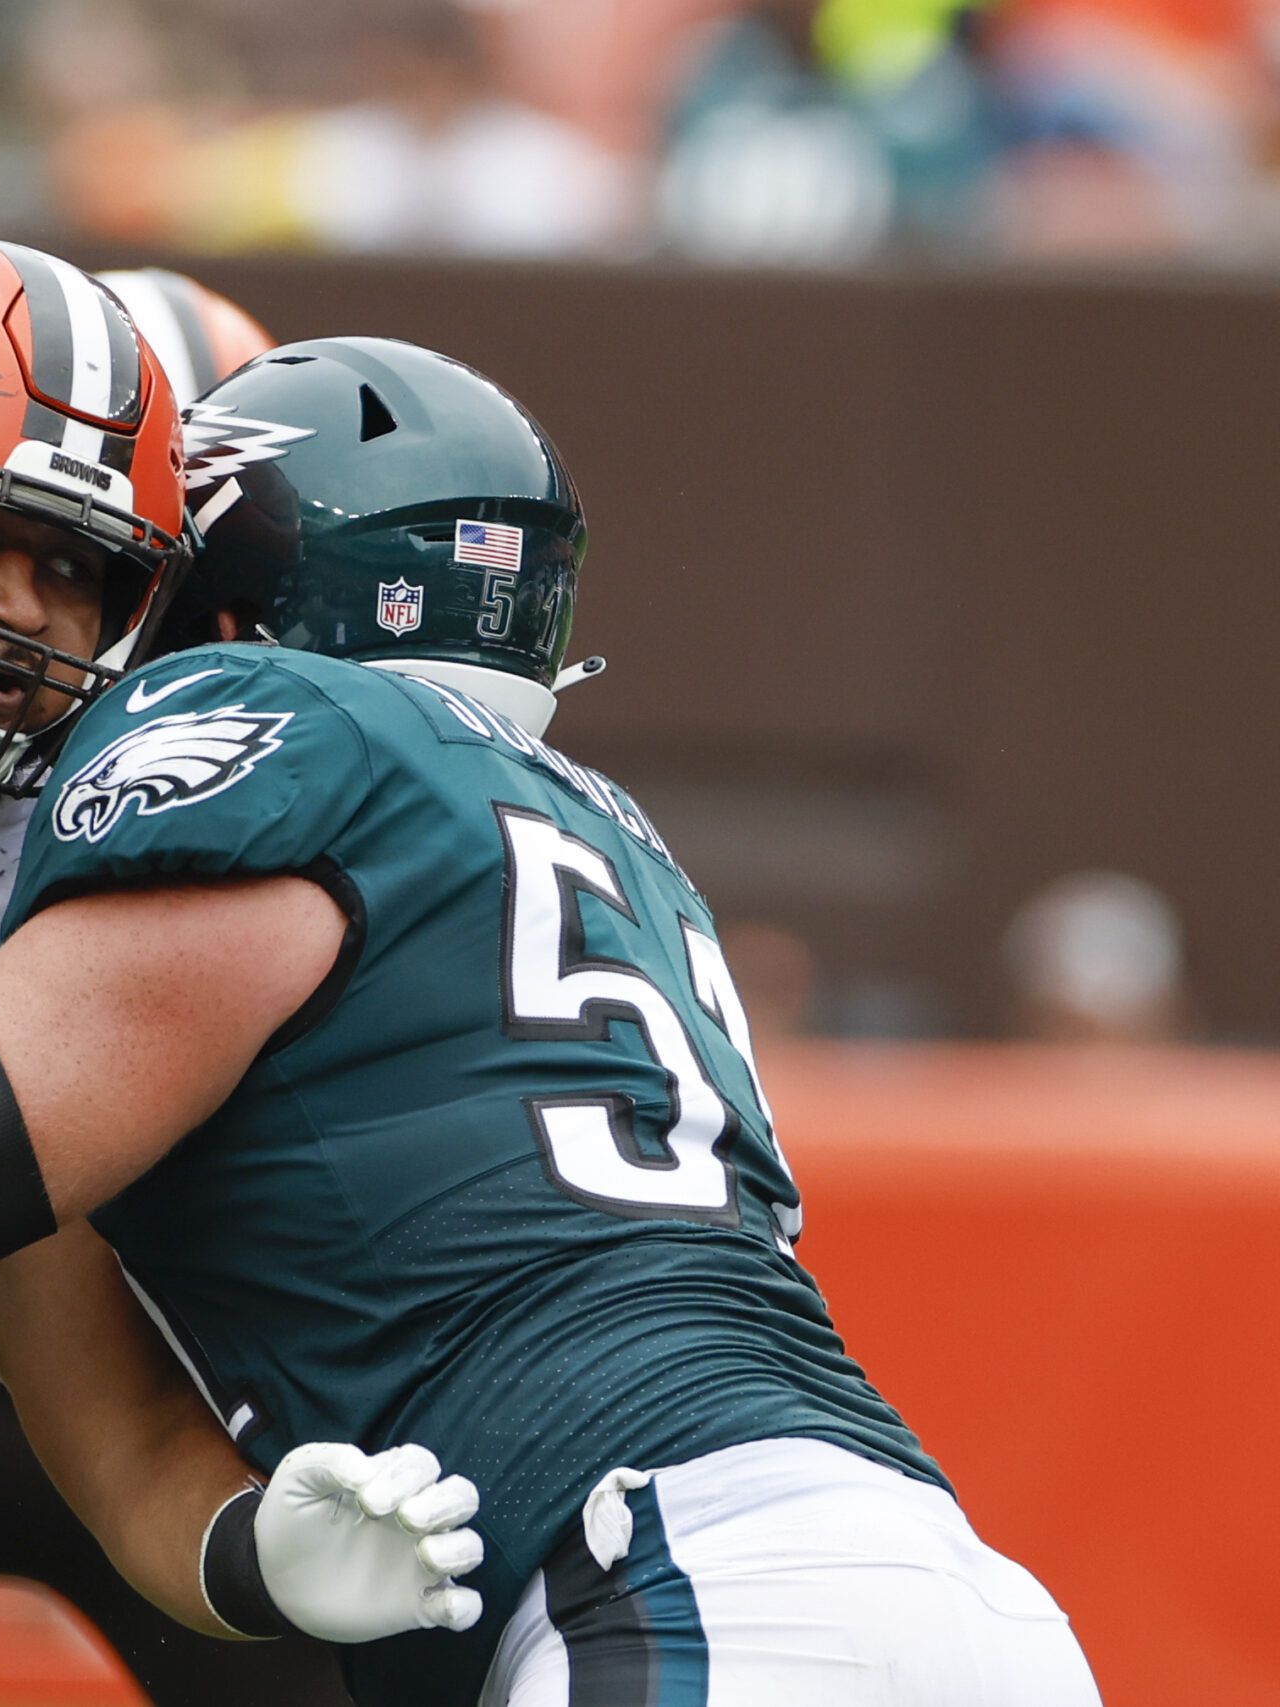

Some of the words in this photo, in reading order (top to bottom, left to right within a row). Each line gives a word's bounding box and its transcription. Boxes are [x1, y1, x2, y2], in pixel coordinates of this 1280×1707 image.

[49, 452, 112, 491] BROWNS
[384, 603, 415, 626] NFL
[477, 568, 563, 656] 51
[491, 798, 803, 1262] 51
